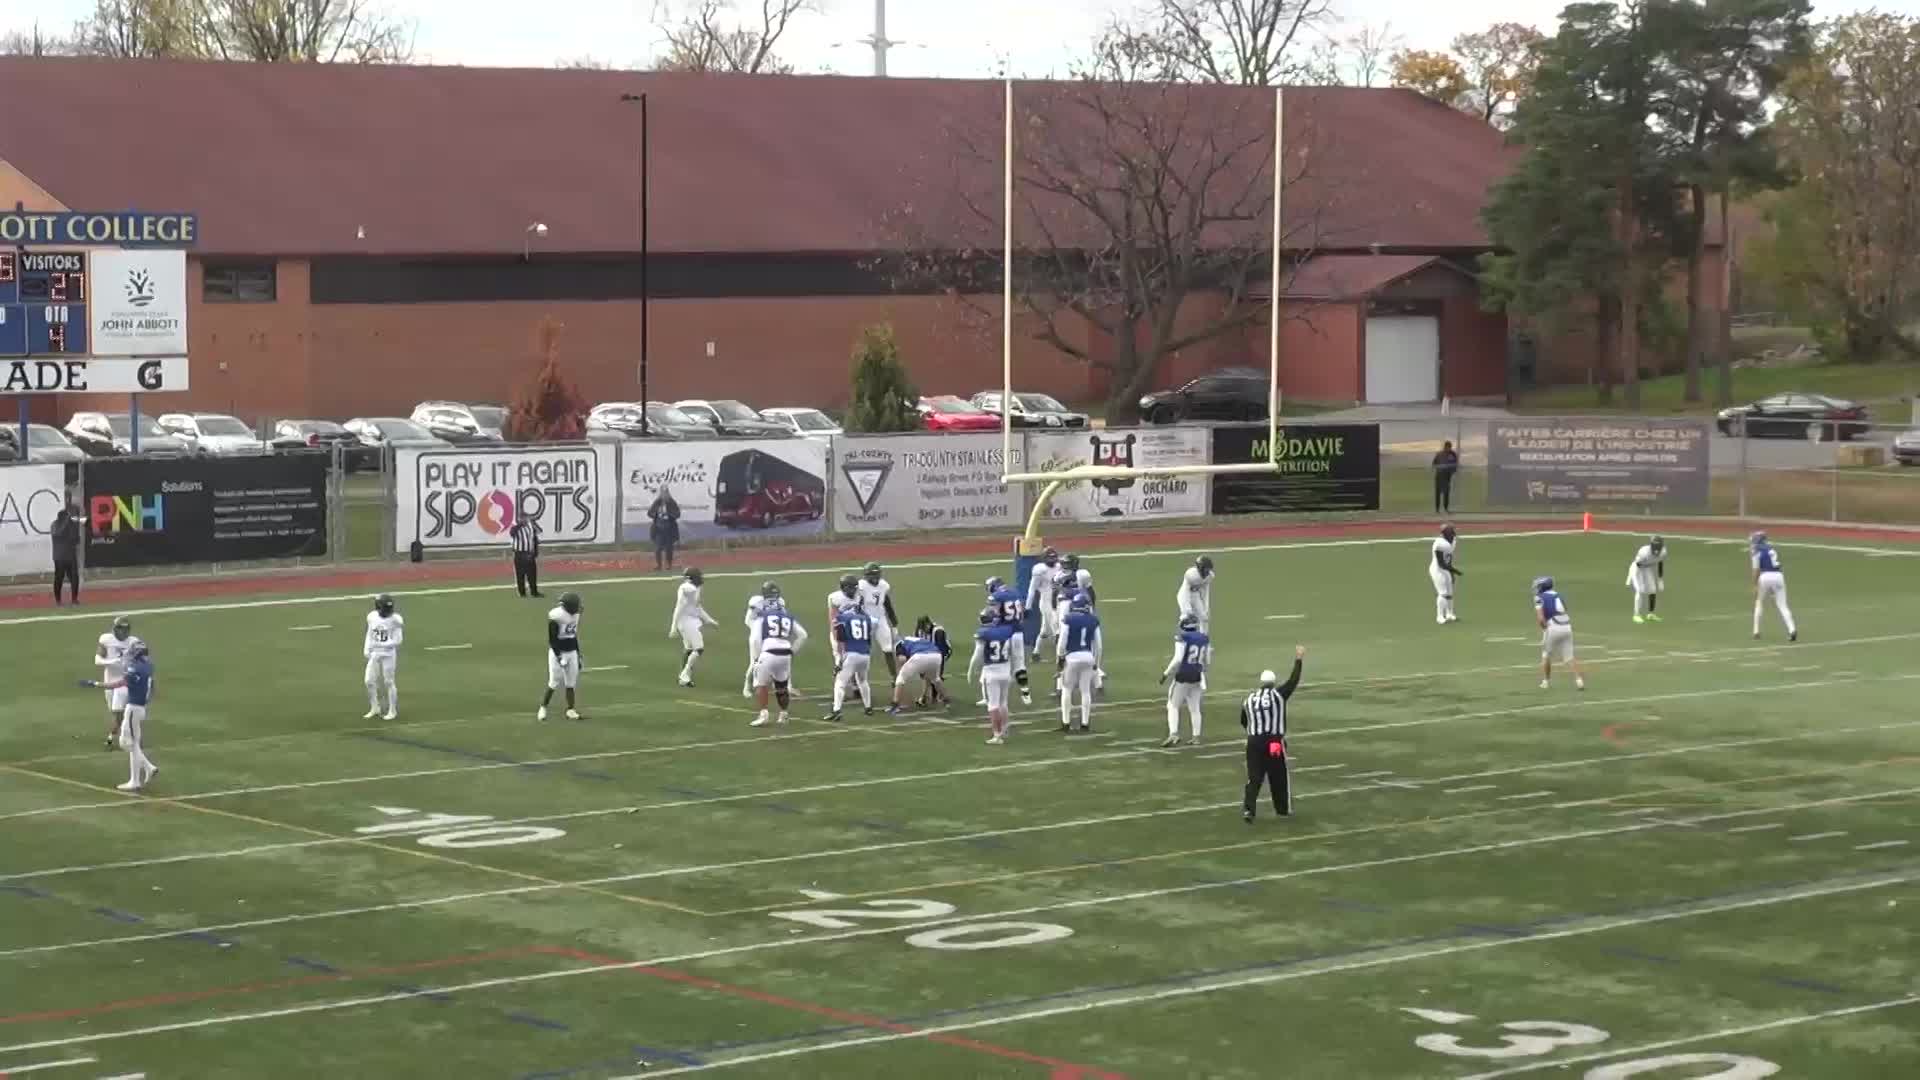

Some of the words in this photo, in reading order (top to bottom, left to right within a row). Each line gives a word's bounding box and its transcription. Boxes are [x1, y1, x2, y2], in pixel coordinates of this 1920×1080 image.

[66, 215, 193, 241] COLLEGE
[23, 255, 80, 270] VISITORS
[51, 272, 84, 300] 27
[101, 319, 133, 330] JOHN
[137, 319, 178, 329] ABBOTT
[49, 325, 64, 352] 4
[137, 361, 162, 390] G
[1508, 439, 1569, 450] LEADER
[1572, 440, 1593, 450] DE
[1634, 428, 1677, 439] CHEZ
[425, 463, 482, 488] PLAY
[491, 462, 511, 486] IT
[517, 459, 589, 485] AGAIN
[631, 466, 706, 485] Excellence
[161, 481, 203, 492] Solutions
[1143, 480, 1188, 495] ORCHARD
[91, 494, 164, 534] PNH
[424, 486, 592, 538] SPORTS
[767, 615, 792, 638] 59
[850, 619, 869, 640] 61
[1080, 627, 1087, 647] 1
[1252, 692, 1271, 710] 76
[353, 812, 567, 849] 10
[767, 899, 1076, 950] 20
